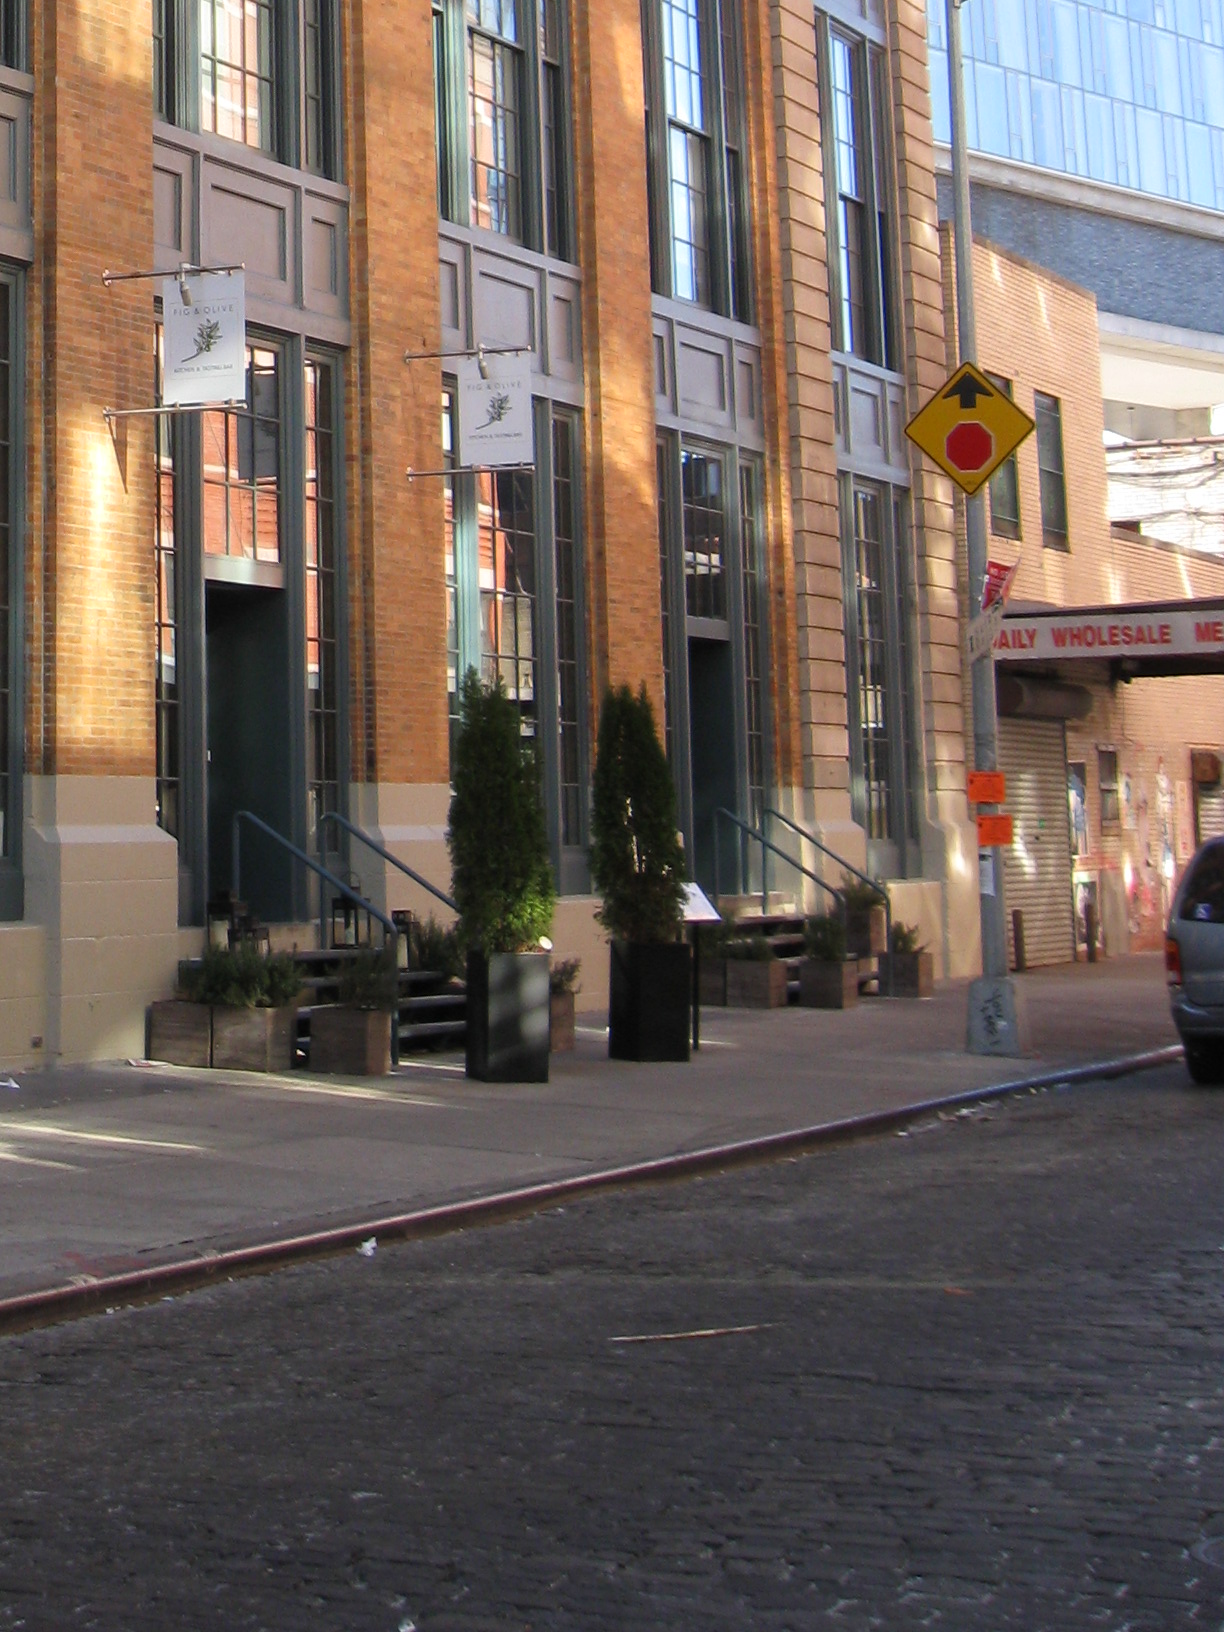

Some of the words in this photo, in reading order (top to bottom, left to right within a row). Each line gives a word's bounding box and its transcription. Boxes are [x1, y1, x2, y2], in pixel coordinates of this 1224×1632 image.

[173, 308, 191, 316] FIG
[194, 307, 200, 315] &
[203, 304, 234, 315] OLIVE
[467, 383, 483, 391] FIG
[494, 380, 521, 390] OLIVE
[1051, 623, 1172, 648] WHOLESALE
